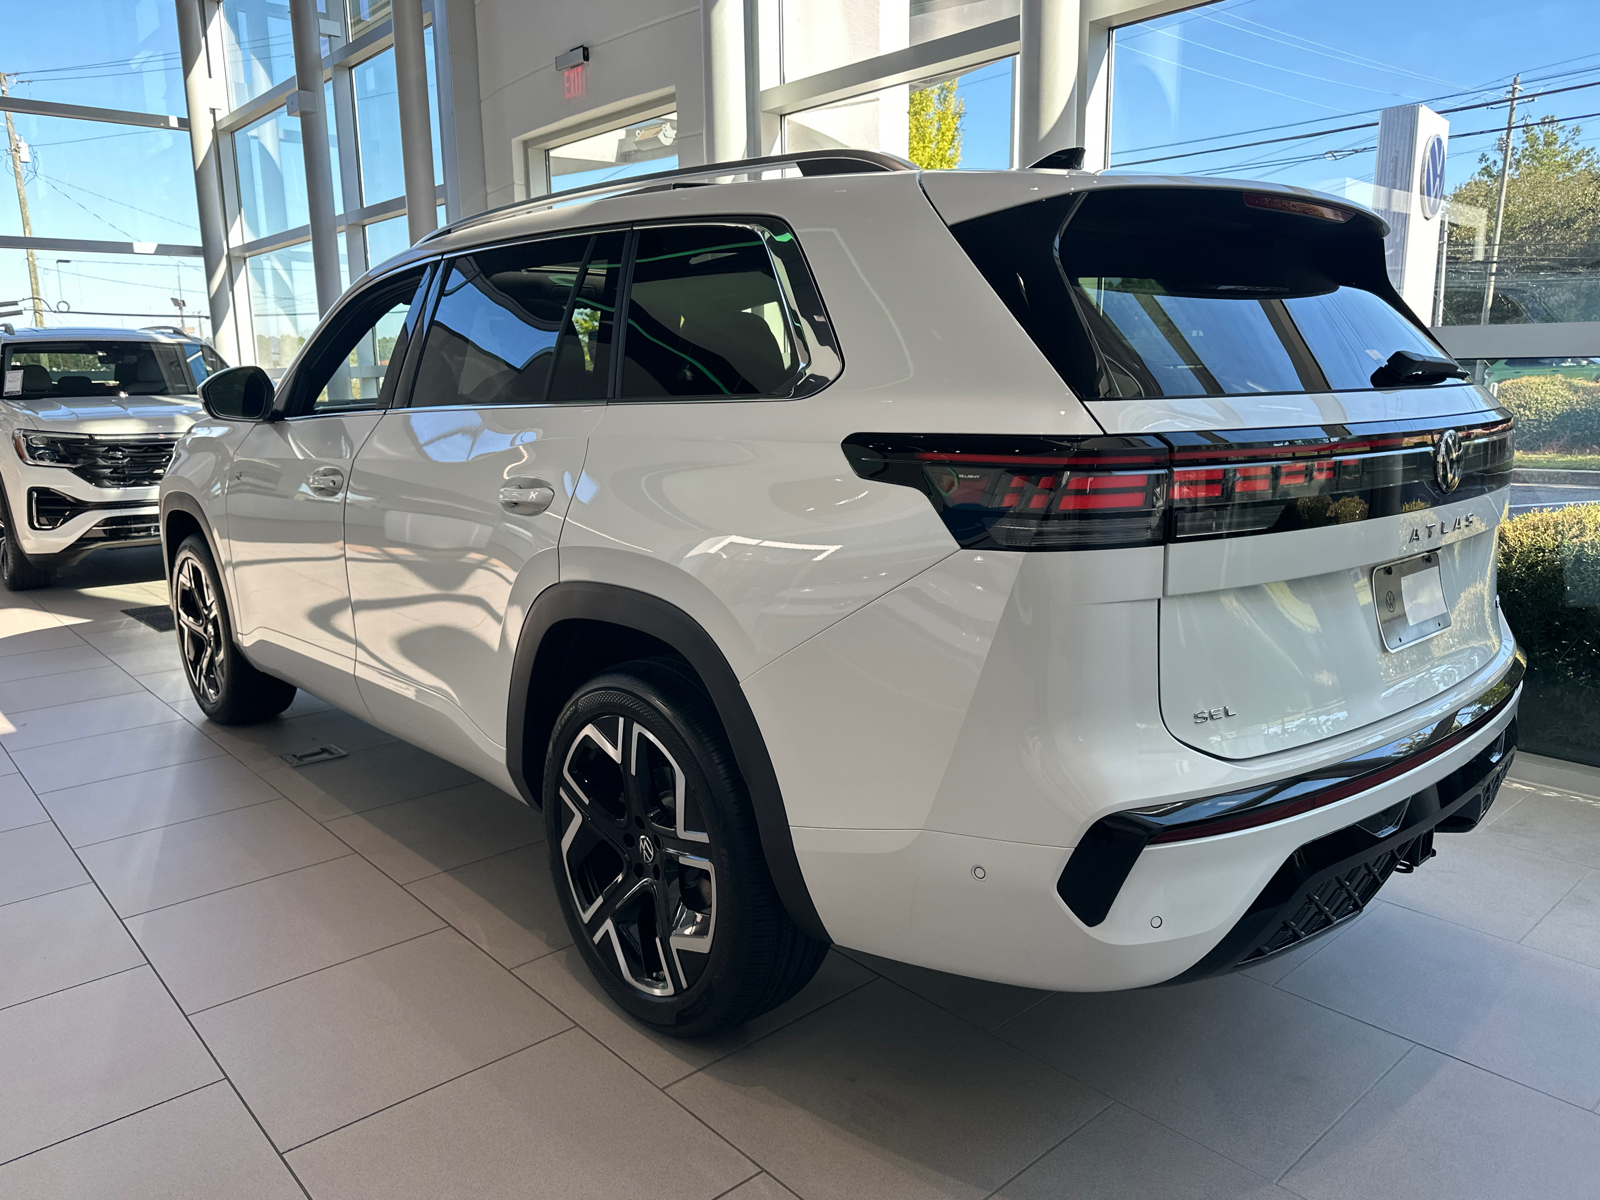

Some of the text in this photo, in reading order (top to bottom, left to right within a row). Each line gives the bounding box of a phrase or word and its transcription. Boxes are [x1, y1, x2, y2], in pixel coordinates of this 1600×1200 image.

[563, 65, 584, 100] EXIT
[1408, 512, 1474, 544] ATLAS
[1193, 705, 1237, 725] SEL
